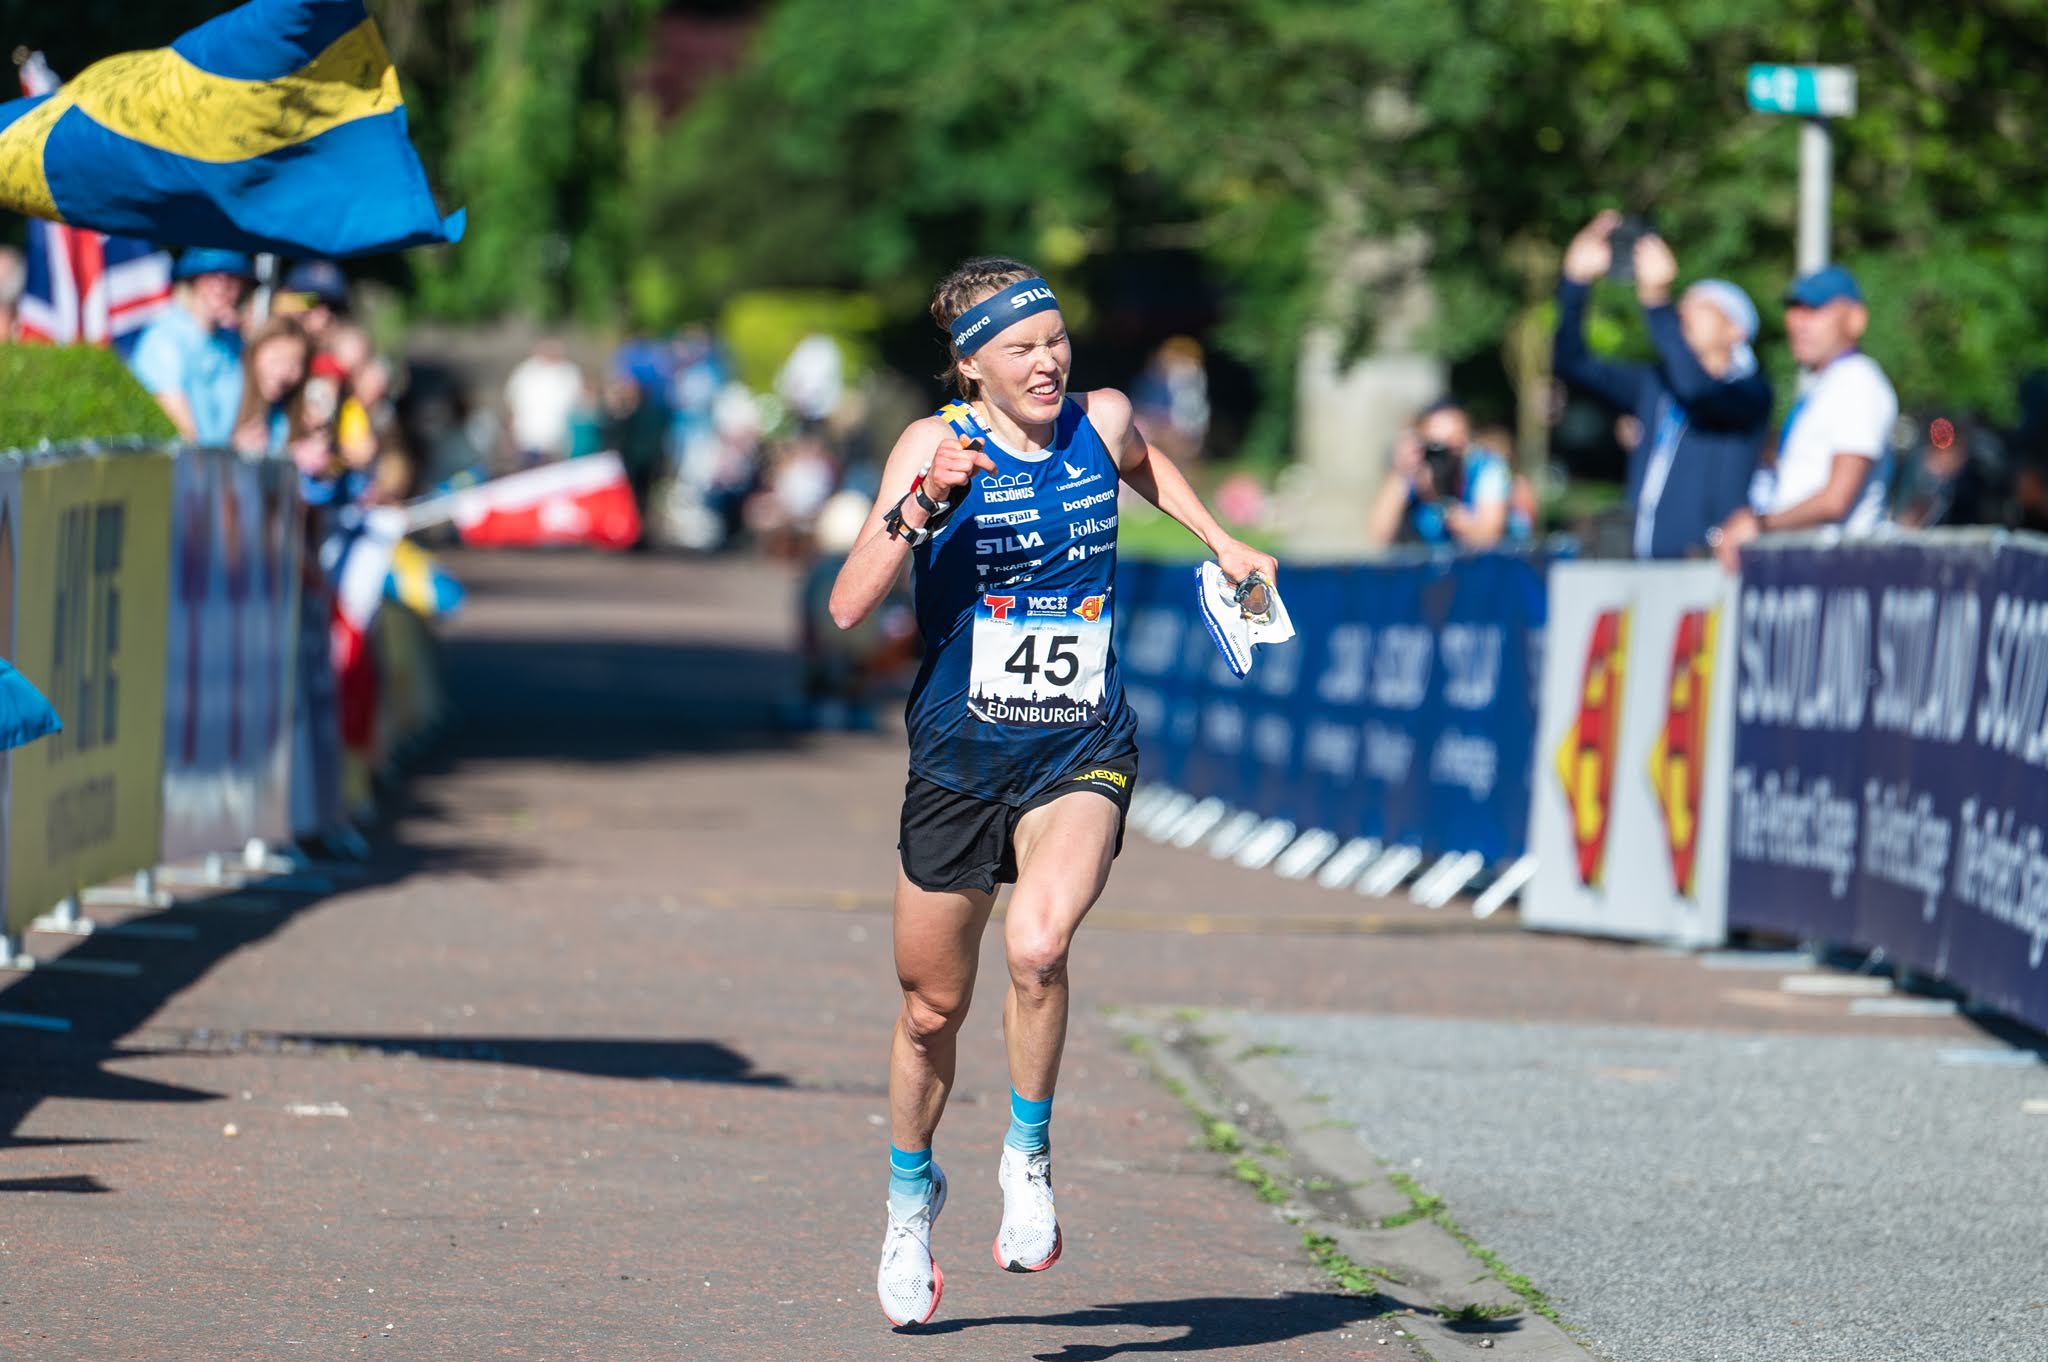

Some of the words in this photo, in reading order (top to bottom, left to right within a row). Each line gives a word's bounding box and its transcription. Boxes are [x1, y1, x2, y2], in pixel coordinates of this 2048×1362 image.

[1010, 287, 1057, 309] SILV
[983, 486, 1035, 504] EKSJÖHUS
[984, 516, 1007, 525] Idre
[1008, 511, 1032, 523] Fjäll
[975, 531, 1045, 555] SILVA
[1027, 596, 1057, 610] WOC
[1004, 635, 1079, 687] 45
[987, 702, 1087, 722] EDINBURGH
